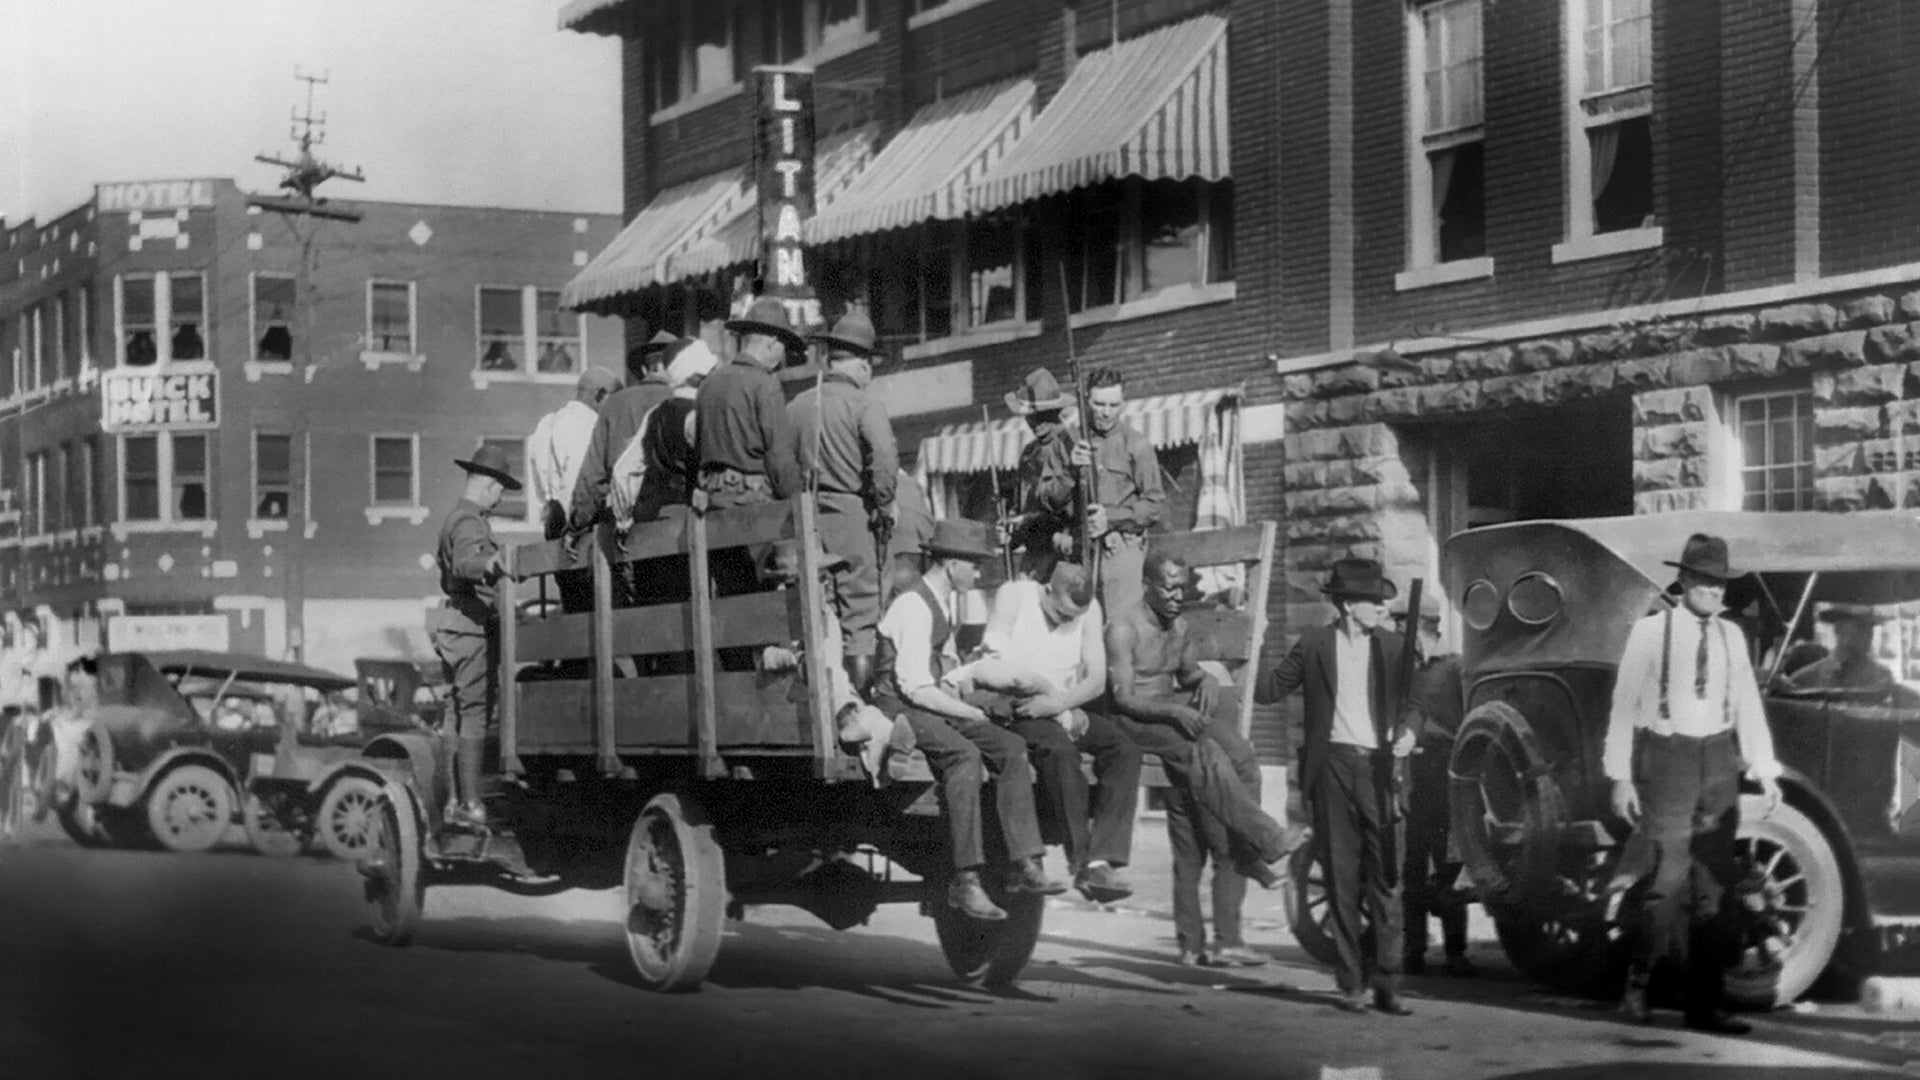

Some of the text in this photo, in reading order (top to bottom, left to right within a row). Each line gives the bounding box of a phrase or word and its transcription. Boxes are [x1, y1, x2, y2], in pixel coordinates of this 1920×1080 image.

[774, 73, 804, 286] LITAN
[101, 182, 210, 209] HOTEL
[110, 400, 210, 425] HOTEL
